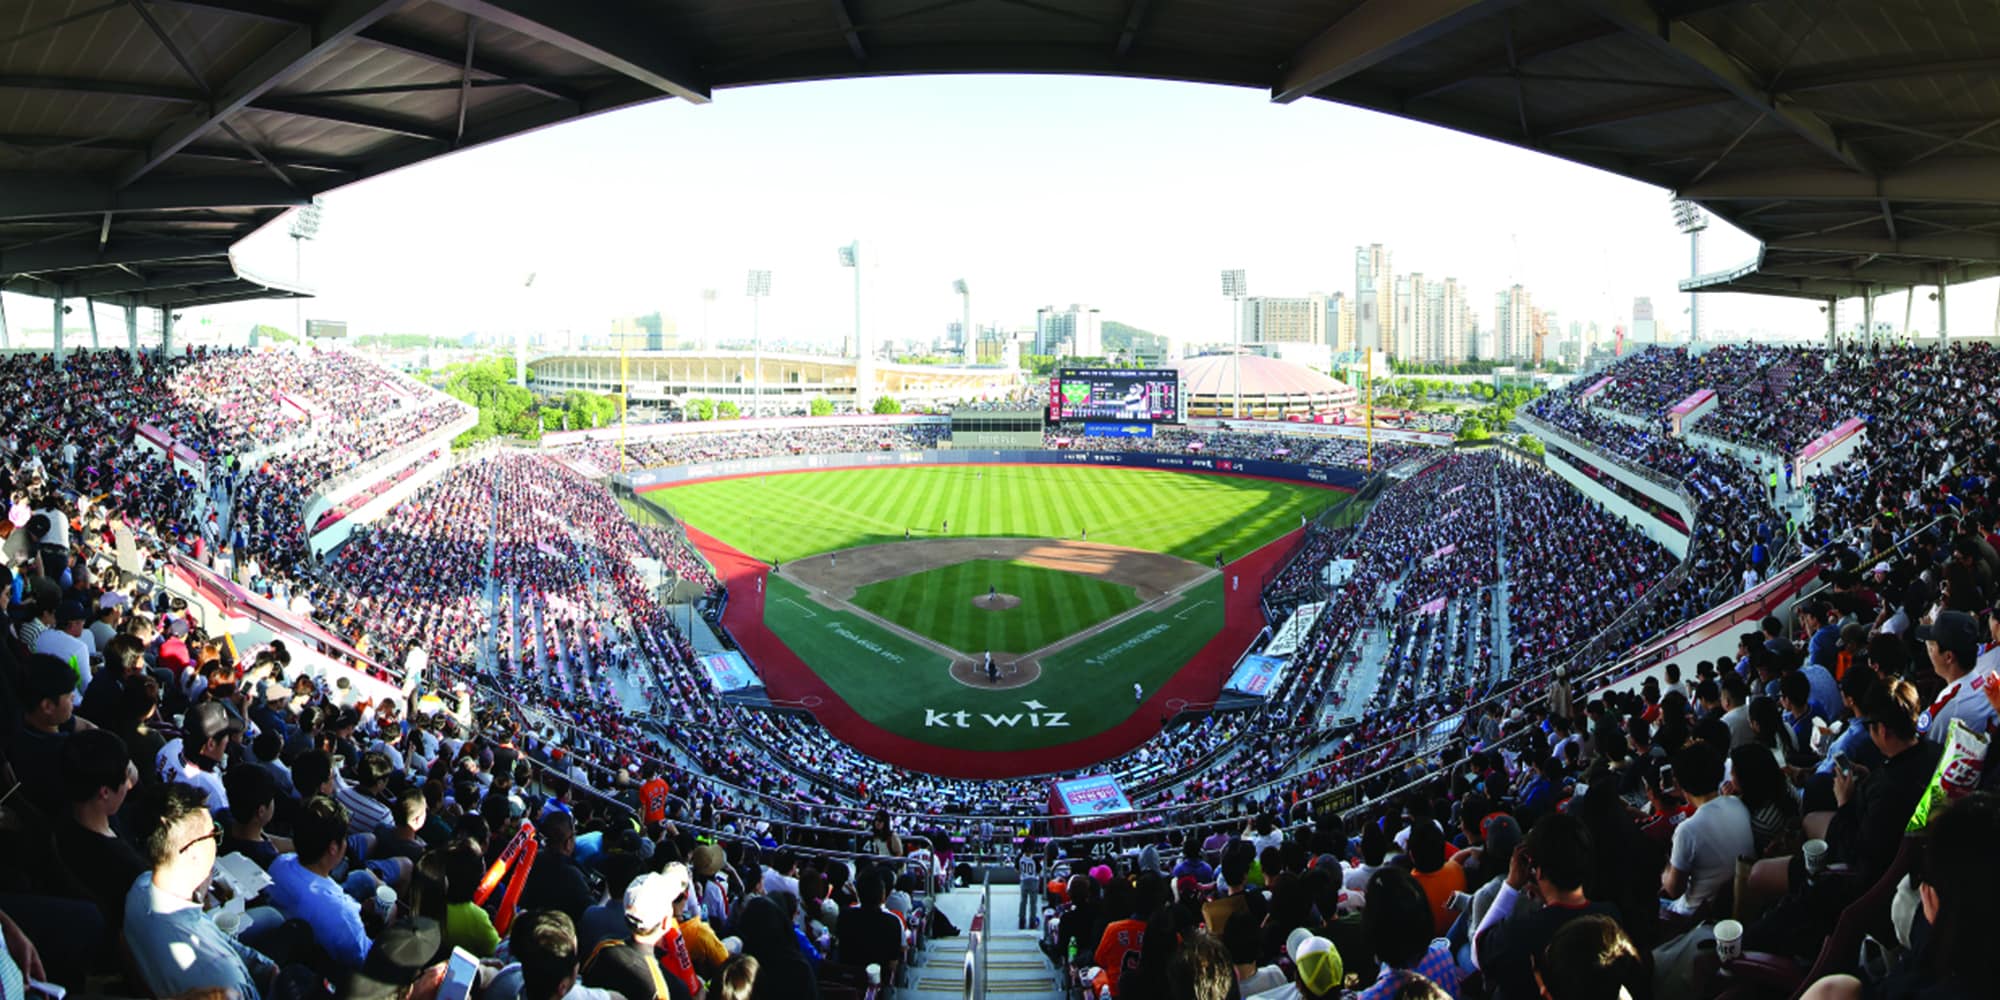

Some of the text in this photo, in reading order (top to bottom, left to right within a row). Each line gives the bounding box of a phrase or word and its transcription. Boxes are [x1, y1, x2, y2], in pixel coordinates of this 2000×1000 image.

[924, 699, 1070, 728] kt wiz
[1090, 841, 1115, 856] 412
